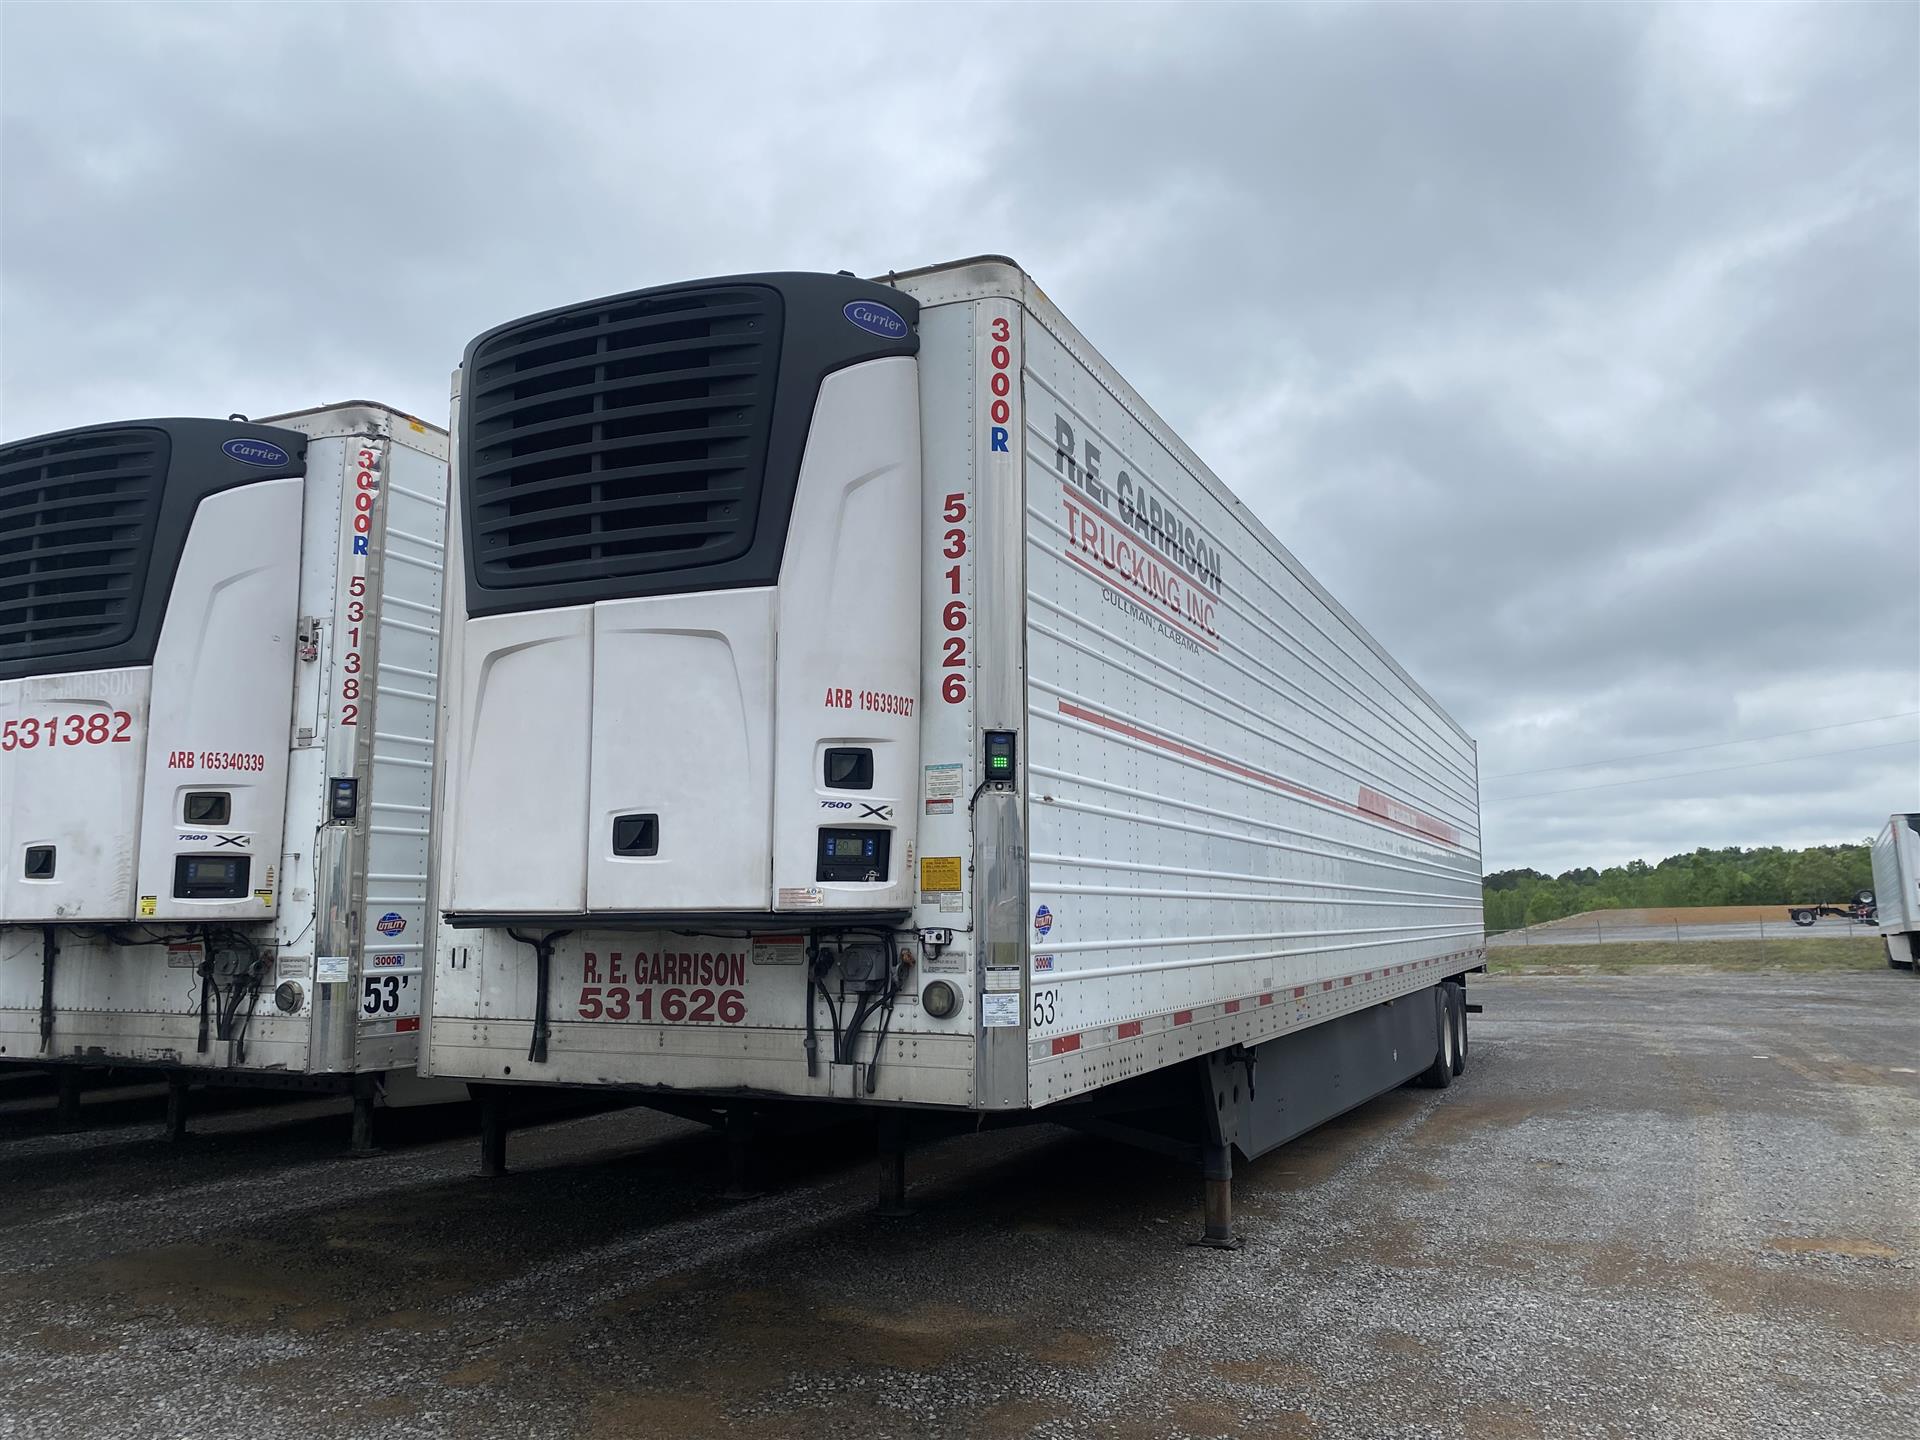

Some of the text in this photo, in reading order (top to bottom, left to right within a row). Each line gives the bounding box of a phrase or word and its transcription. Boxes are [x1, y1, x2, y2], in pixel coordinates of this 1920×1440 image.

[852, 306, 902, 332] Carrier
[991, 317, 1010, 452] 3000R
[231, 443, 282, 463] Carrier
[353, 450, 375, 556] 3000R
[1117, 470, 1221, 595] GARRISON
[1063, 500, 1182, 616] TRUCKING
[942, 493, 967, 704] 531626
[341, 576, 366, 726] 531382
[1157, 623, 1201, 656] ALABAMA
[825, 687, 914, 717] ARB 196393027
[1, 711, 132, 751] 531382
[168, 751, 265, 772] ARB 165340339
[820, 800, 852, 810] 7500
[378, 920, 406, 931] UTILITY
[1035, 916, 1053, 928] UTILITY
[375, 956, 402, 967] 3000R
[583, 951, 746, 987] R. E. GARRISON
[578, 986, 746, 1024] 531626
[1033, 989, 1058, 1027] 53'
